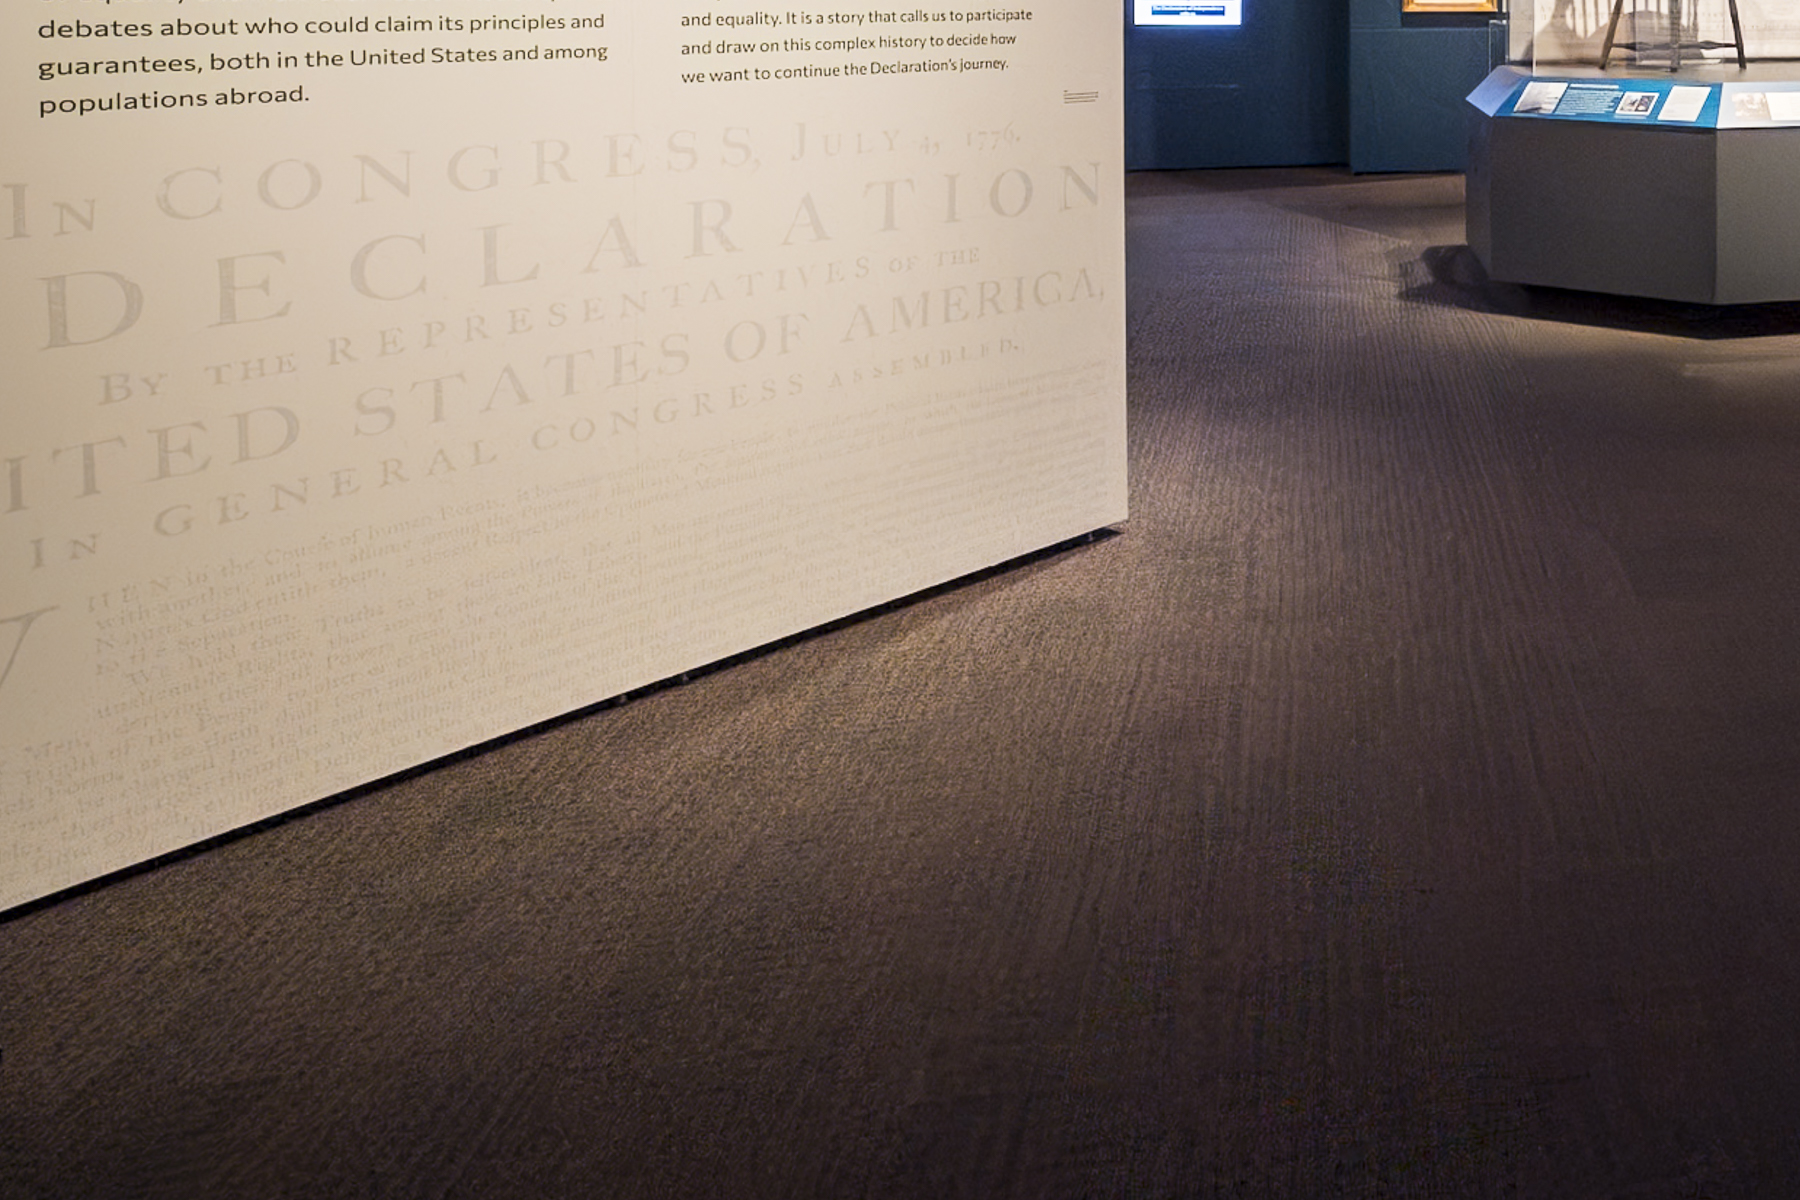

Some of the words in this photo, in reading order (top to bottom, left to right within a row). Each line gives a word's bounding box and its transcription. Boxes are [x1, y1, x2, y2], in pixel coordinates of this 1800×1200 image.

[682, 73, 705, 83] we
[709, 68, 750, 82] want
[754, 68, 771, 80] to
[775, 64, 840, 79] continue
[844, 62, 867, 76] the
[871, 58, 957, 74] Declaration’s
[960, 58, 1008, 73] journey.
[36, 161, 1101, 351] DECLARATION
[353, 332, 692, 438] STATES
[723, 312, 812, 364] OF
[839, 266, 1105, 345] AMERICA,
